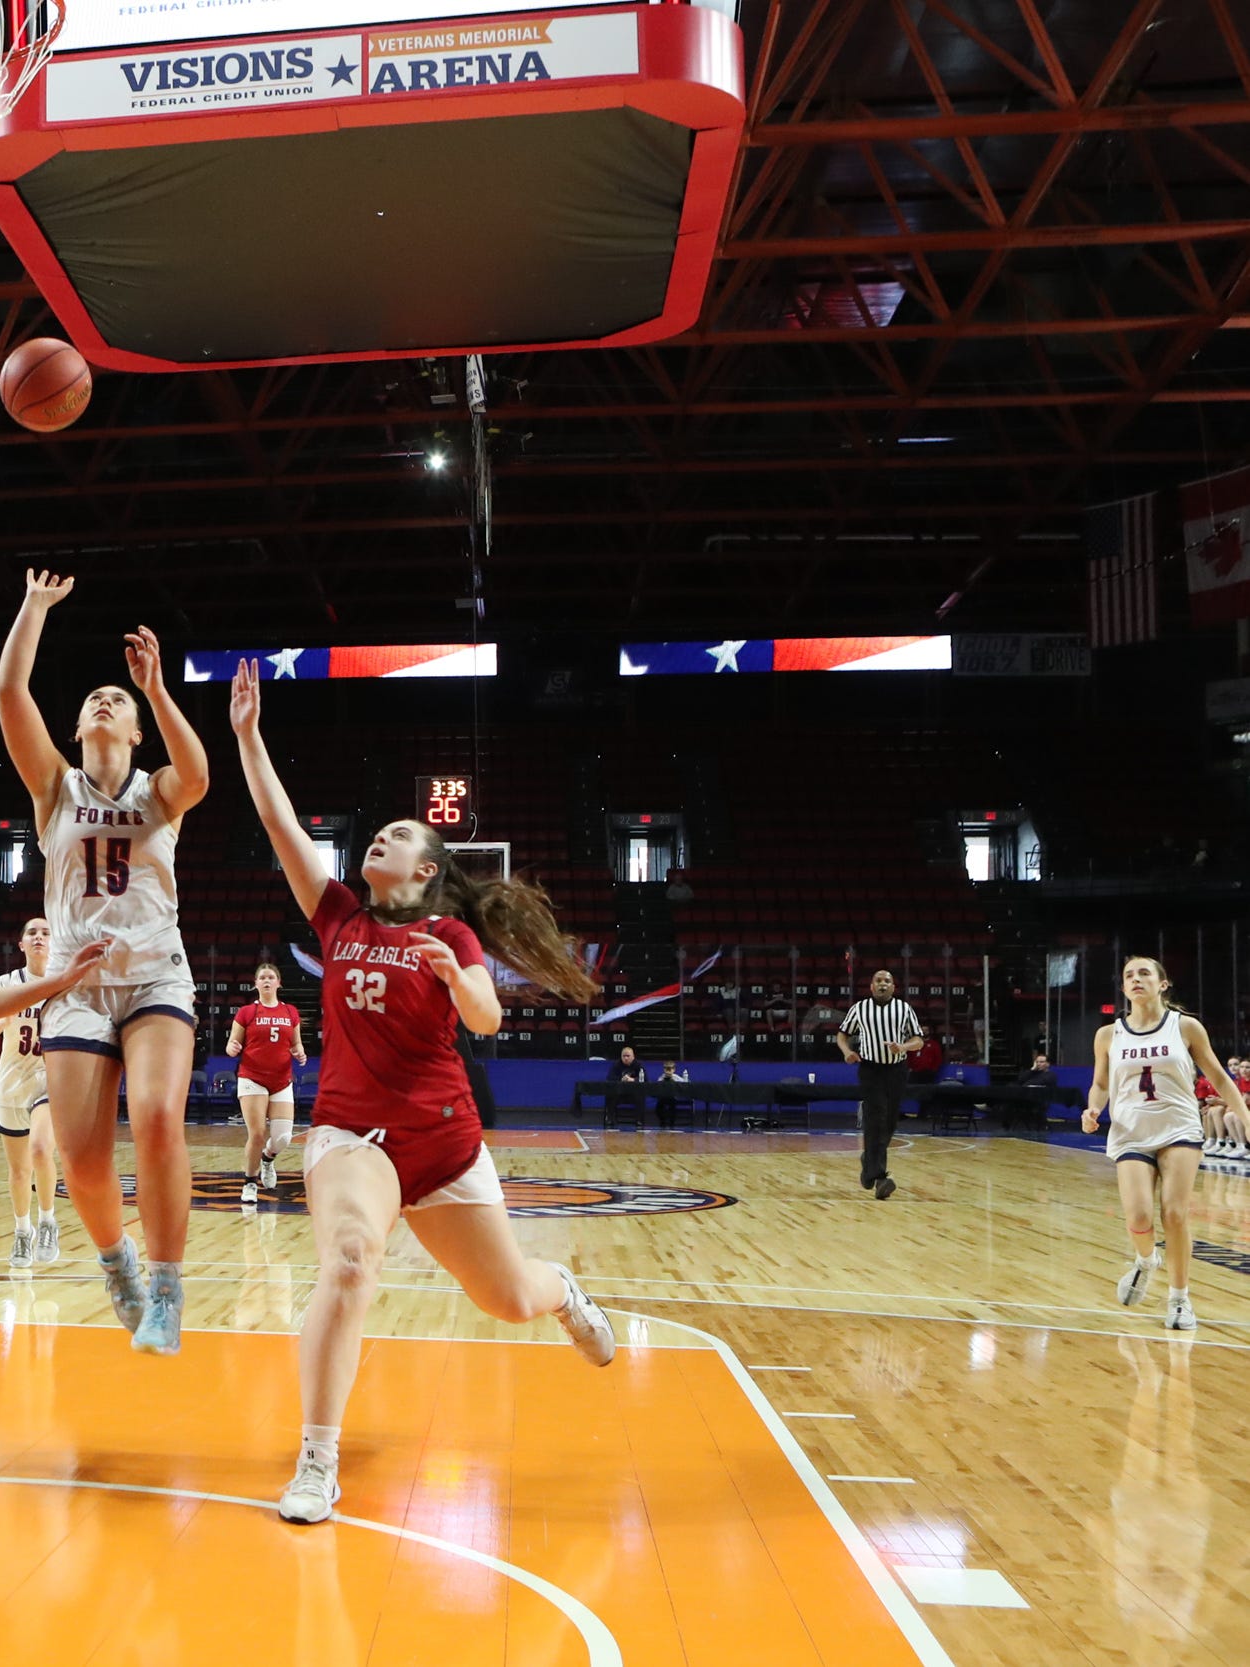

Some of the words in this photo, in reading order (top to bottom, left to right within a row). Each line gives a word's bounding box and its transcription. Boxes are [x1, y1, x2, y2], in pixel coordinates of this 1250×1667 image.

[378, 33, 455, 52] VETERANS
[459, 26, 541, 46] MEMORIAL
[120, 47, 314, 93] VISIONS
[370, 51, 551, 94] ARENA
[131, 96, 196, 109] FEDERAL
[203, 91, 256, 103] CREDIT
[263, 85, 314, 98] UNION
[1046, 648, 1088, 671] DRIVE
[432, 780, 467, 797] 3:35
[74, 806, 145, 827] FORKS
[428, 797, 461, 823] 26
[80, 837, 132, 898] 15
[333, 941, 369, 962] LADY
[366, 946, 422, 972] EAGLES
[345, 968, 387, 1014] 32
[18, 1007, 41, 1019] FOR
[256, 1017, 271, 1025] LADY
[272, 1018, 291, 1026] EAGLES
[270, 1027, 280, 1042] 5
[1121, 1045, 1169, 1060] FORKS
[1138, 1065, 1160, 1102] 4
